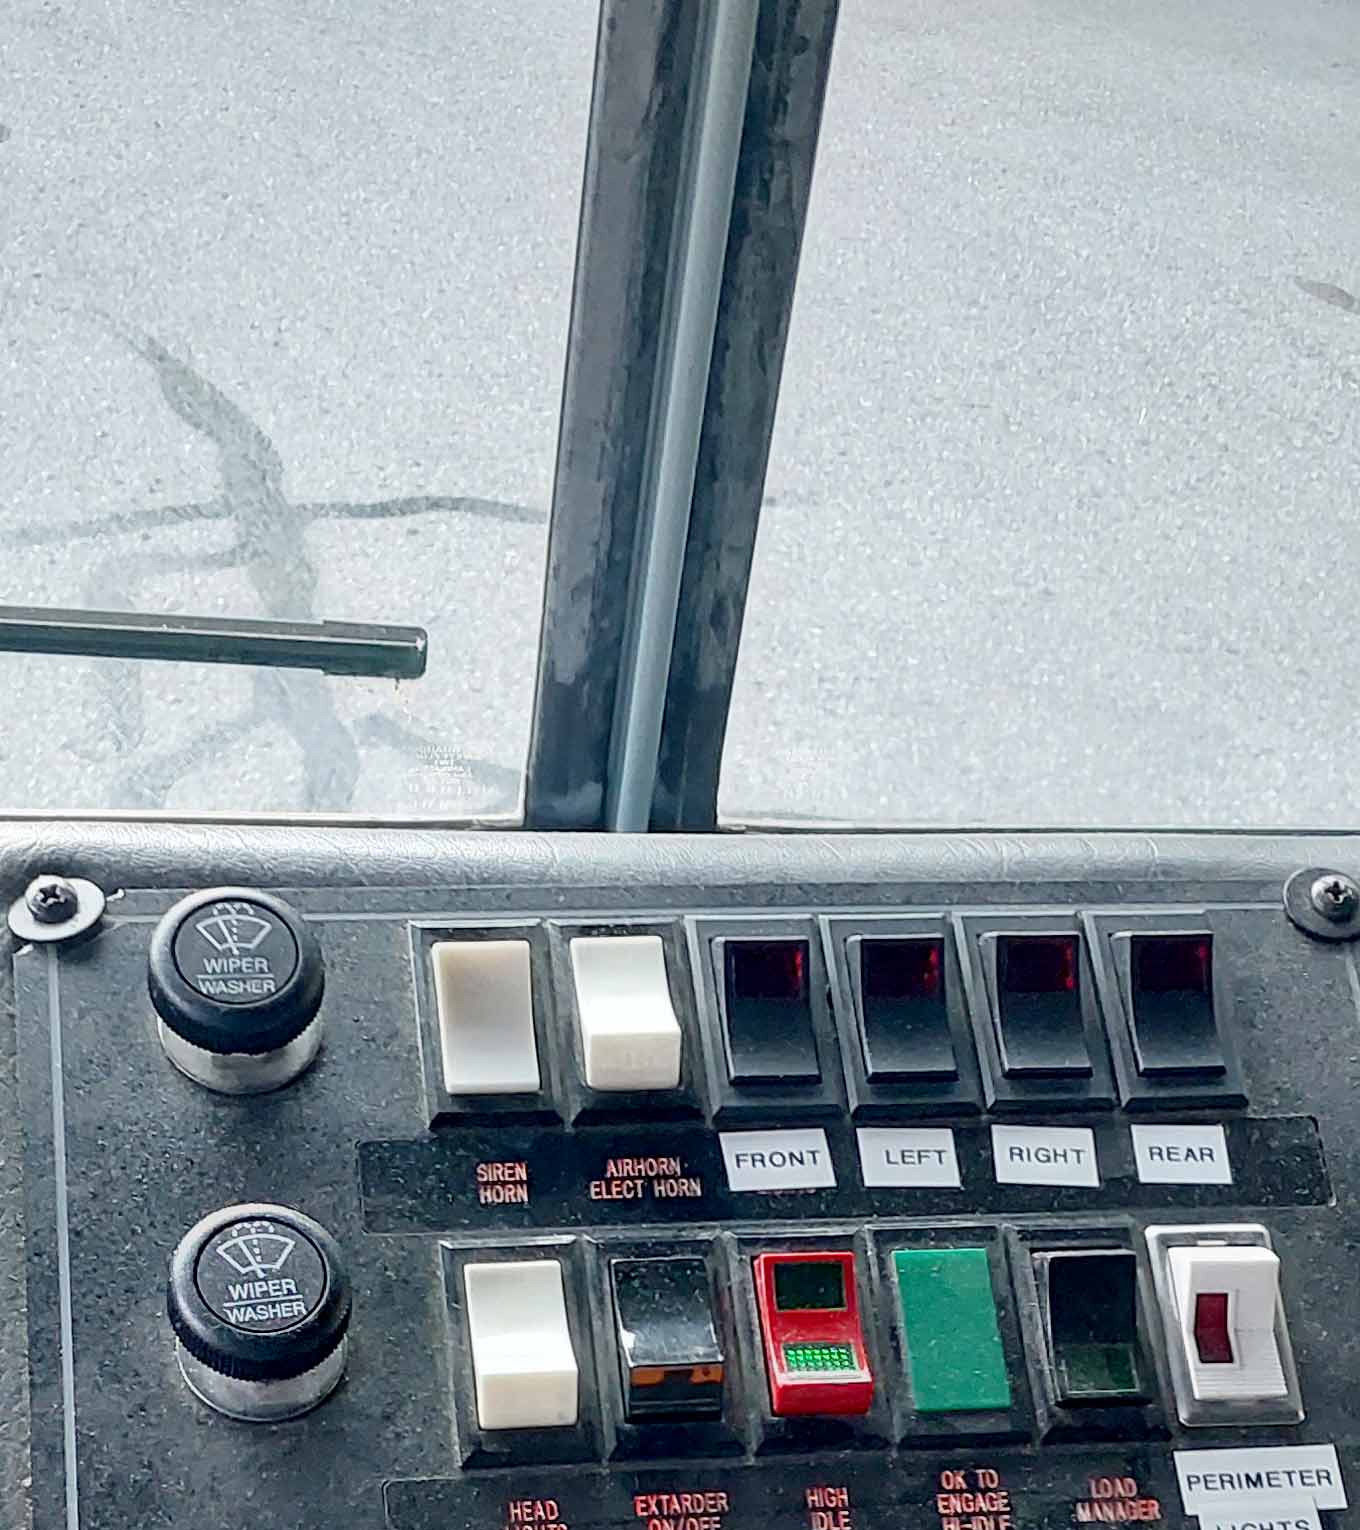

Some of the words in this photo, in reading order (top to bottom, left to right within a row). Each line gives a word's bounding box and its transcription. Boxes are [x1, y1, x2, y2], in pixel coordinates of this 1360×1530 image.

[203, 957, 268, 974] WIPER
[198, 978, 275, 995] WASHER
[735, 1150, 820, 1168] FRONT
[885, 1149, 947, 1165] LEFT
[1009, 1147, 1086, 1164] RIGHT
[1150, 1146, 1215, 1163] REAR
[477, 1162, 527, 1182] SIREN
[606, 1157, 680, 1178] AIRHORN
[479, 1184, 528, 1204] HORN
[590, 1180, 643, 1200] ELECT
[654, 1178, 701, 1199] HORN
[228, 1278, 296, 1300] WIPER
[224, 1301, 307, 1324] WASHER
[941, 1470, 968, 1489] OK
[976, 1468, 999, 1488] TO
[1089, 1477, 1137, 1497] LOAD
[1187, 1468, 1333, 1491] PERIMETER
[634, 1492, 729, 1517] EXTARDER
[807, 1486, 848, 1508] HIGH
[937, 1491, 1010, 1515] ENGAGE
[509, 1500, 558, 1522] HEAD
[1076, 1498, 1160, 1523] MANAGER
